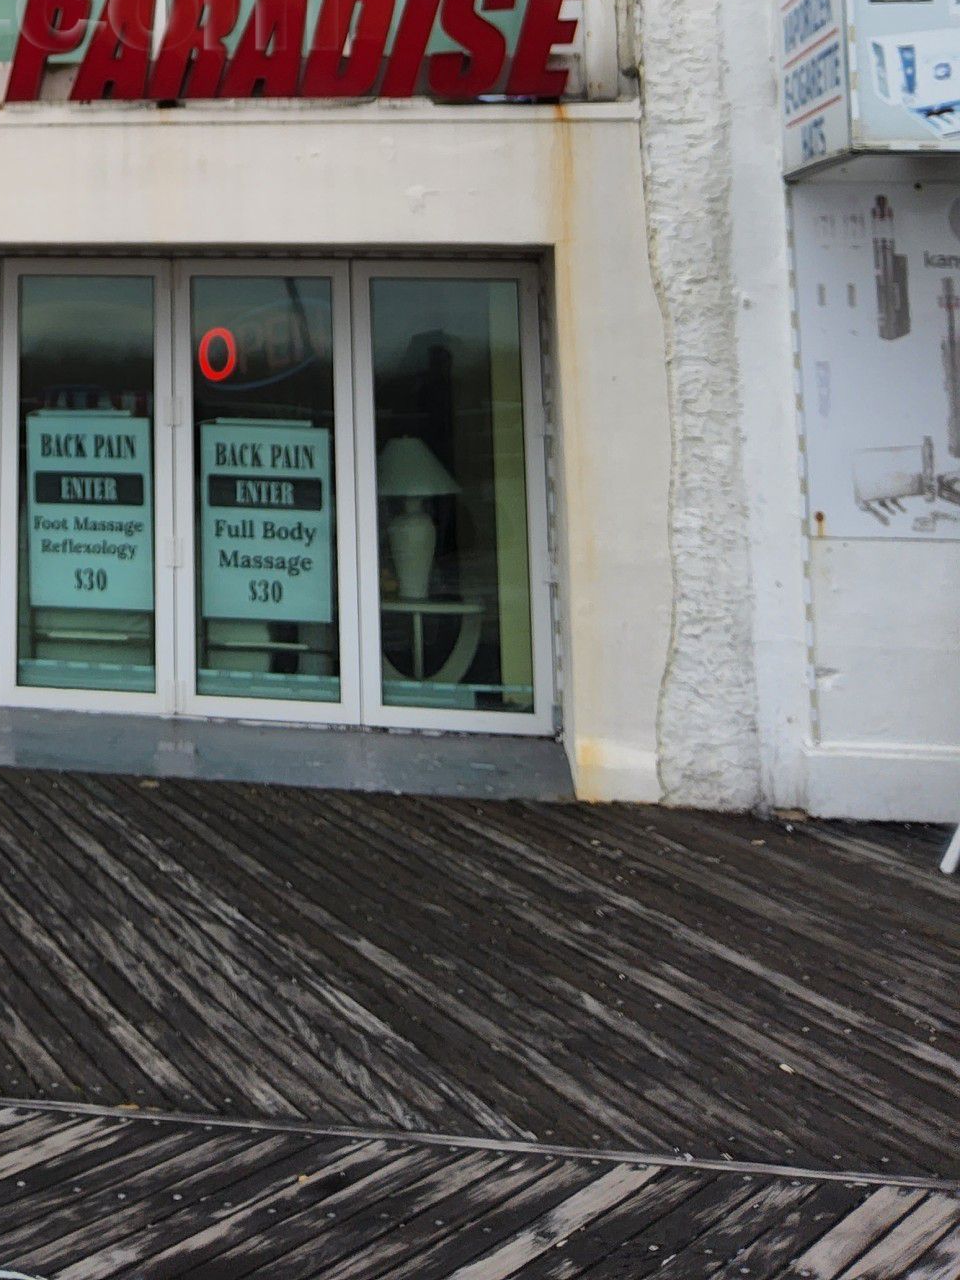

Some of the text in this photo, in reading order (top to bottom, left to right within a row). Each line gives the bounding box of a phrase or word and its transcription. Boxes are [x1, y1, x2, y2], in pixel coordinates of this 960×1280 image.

[41, 433, 136, 459] BACK PAIN
[215, 443, 315, 469] BACK PAIN
[60, 476, 117, 500] ENTER
[235, 480, 295, 505] ENTER
[34, 515, 144, 537] Foot Massage
[214, 519, 316, 548] Full Body
[41, 538, 137, 560] Reflexology
[219, 549, 313, 576] Massage
[74, 567, 108, 591] $30
[248, 579, 283, 603] $30
